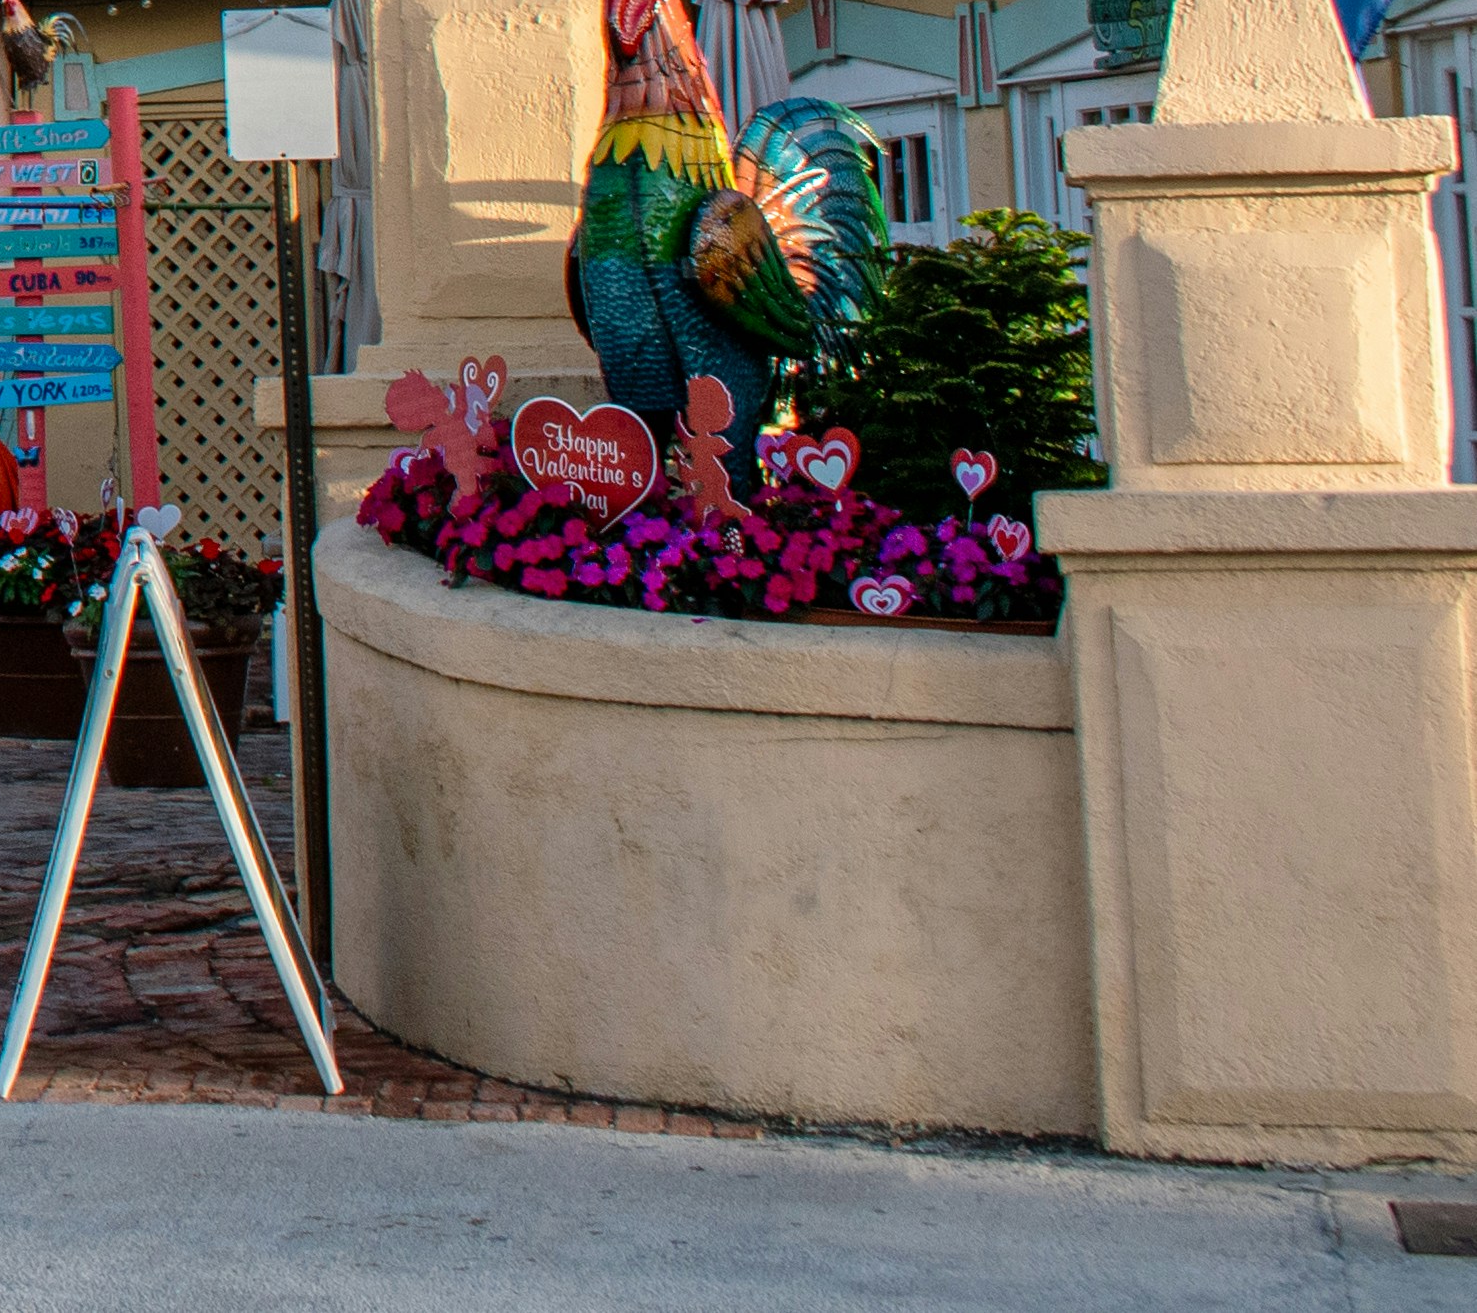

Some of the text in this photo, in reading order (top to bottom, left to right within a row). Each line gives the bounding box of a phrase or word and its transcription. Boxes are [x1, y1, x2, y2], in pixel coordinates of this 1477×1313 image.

[33, 127, 89, 146] Shop
[11, 163, 77, 184] WEST
[9, 272, 62, 293] CUBA
[28, 309, 109, 332] Vegas
[11, 381, 67, 404] YORK
[563, 481, 608, 518] Day
